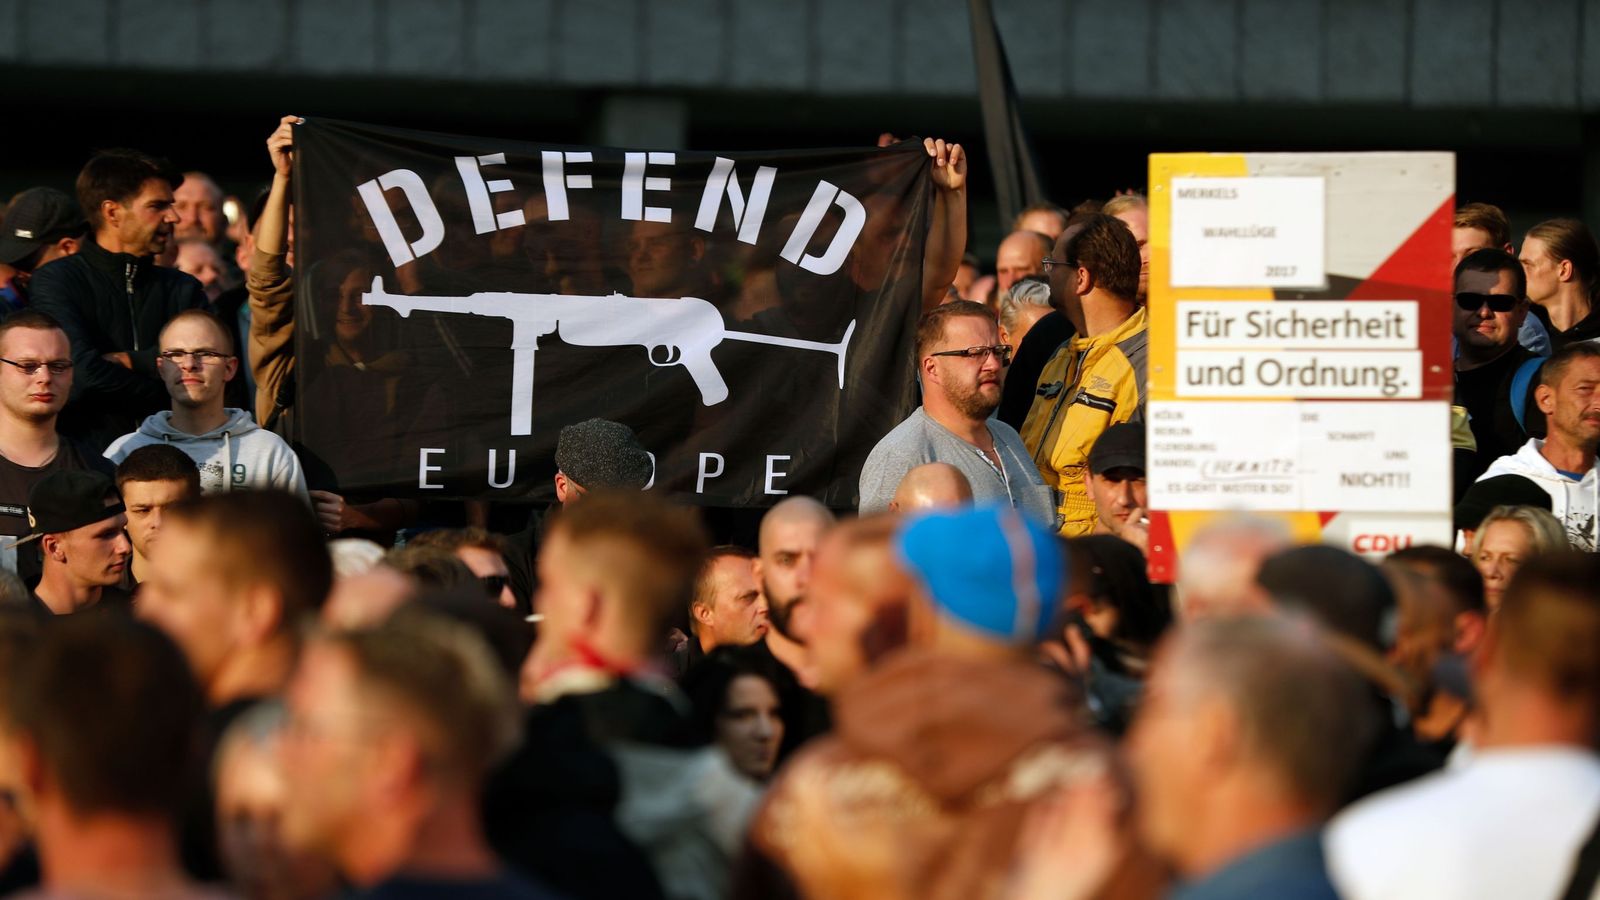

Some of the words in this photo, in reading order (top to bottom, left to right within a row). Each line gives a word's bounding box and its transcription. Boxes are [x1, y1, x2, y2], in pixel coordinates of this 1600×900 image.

[1177, 188, 1238, 199] MERKELS
[356, 150, 866, 276] DEFEND
[1202, 225, 1277, 238] WAHLLÜGE
[1265, 265, 1298, 277] 2017
[1187, 310, 1235, 338] Für
[1246, 308, 1406, 339] Sicherheit
[1186, 357, 1245, 386] und
[1256, 357, 1409, 397] Ordnung.
[418, 447, 792, 495] EUPE
[1340, 472, 1411, 488] NICHT!!
[1353, 534, 1413, 554] CDU
